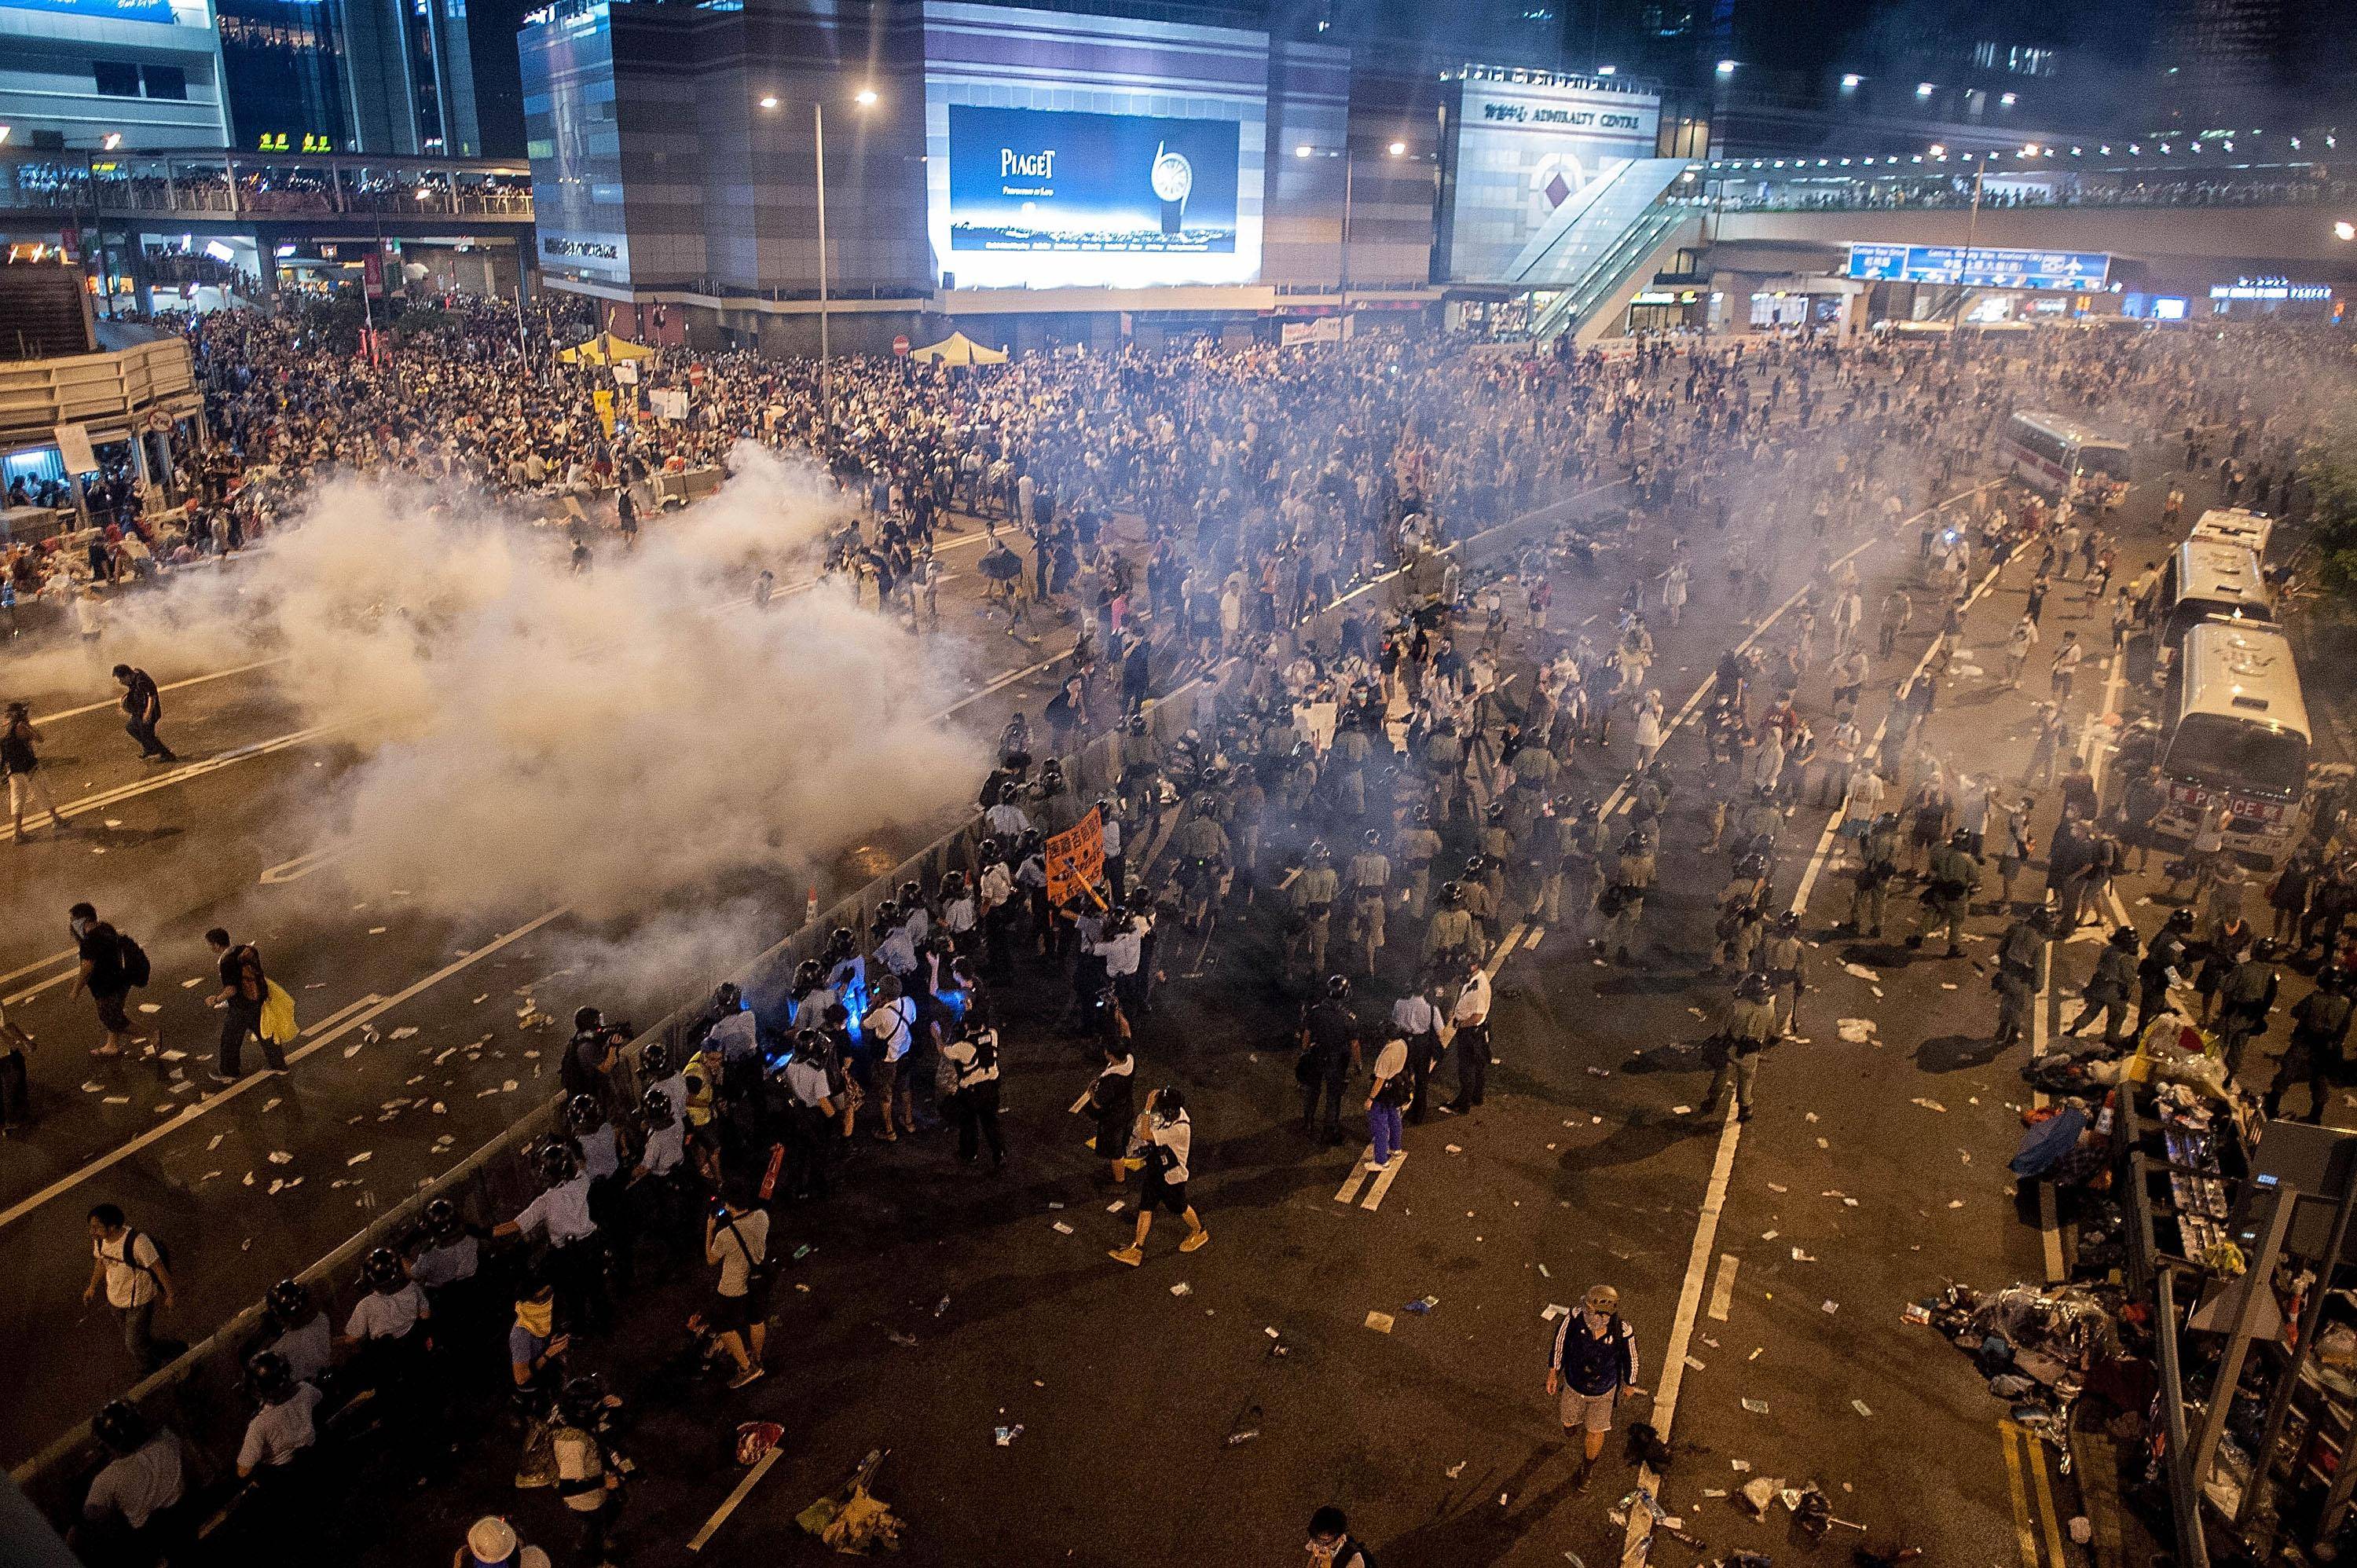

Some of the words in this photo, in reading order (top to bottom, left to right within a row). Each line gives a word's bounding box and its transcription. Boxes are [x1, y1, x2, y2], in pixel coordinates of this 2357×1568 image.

[1532, 108, 1596, 126] ADMIRALTY
[1600, 114, 1640, 130] CENTRE
[1001, 148, 1056, 179] PIAGET
[2194, 790, 2257, 816] POICE
